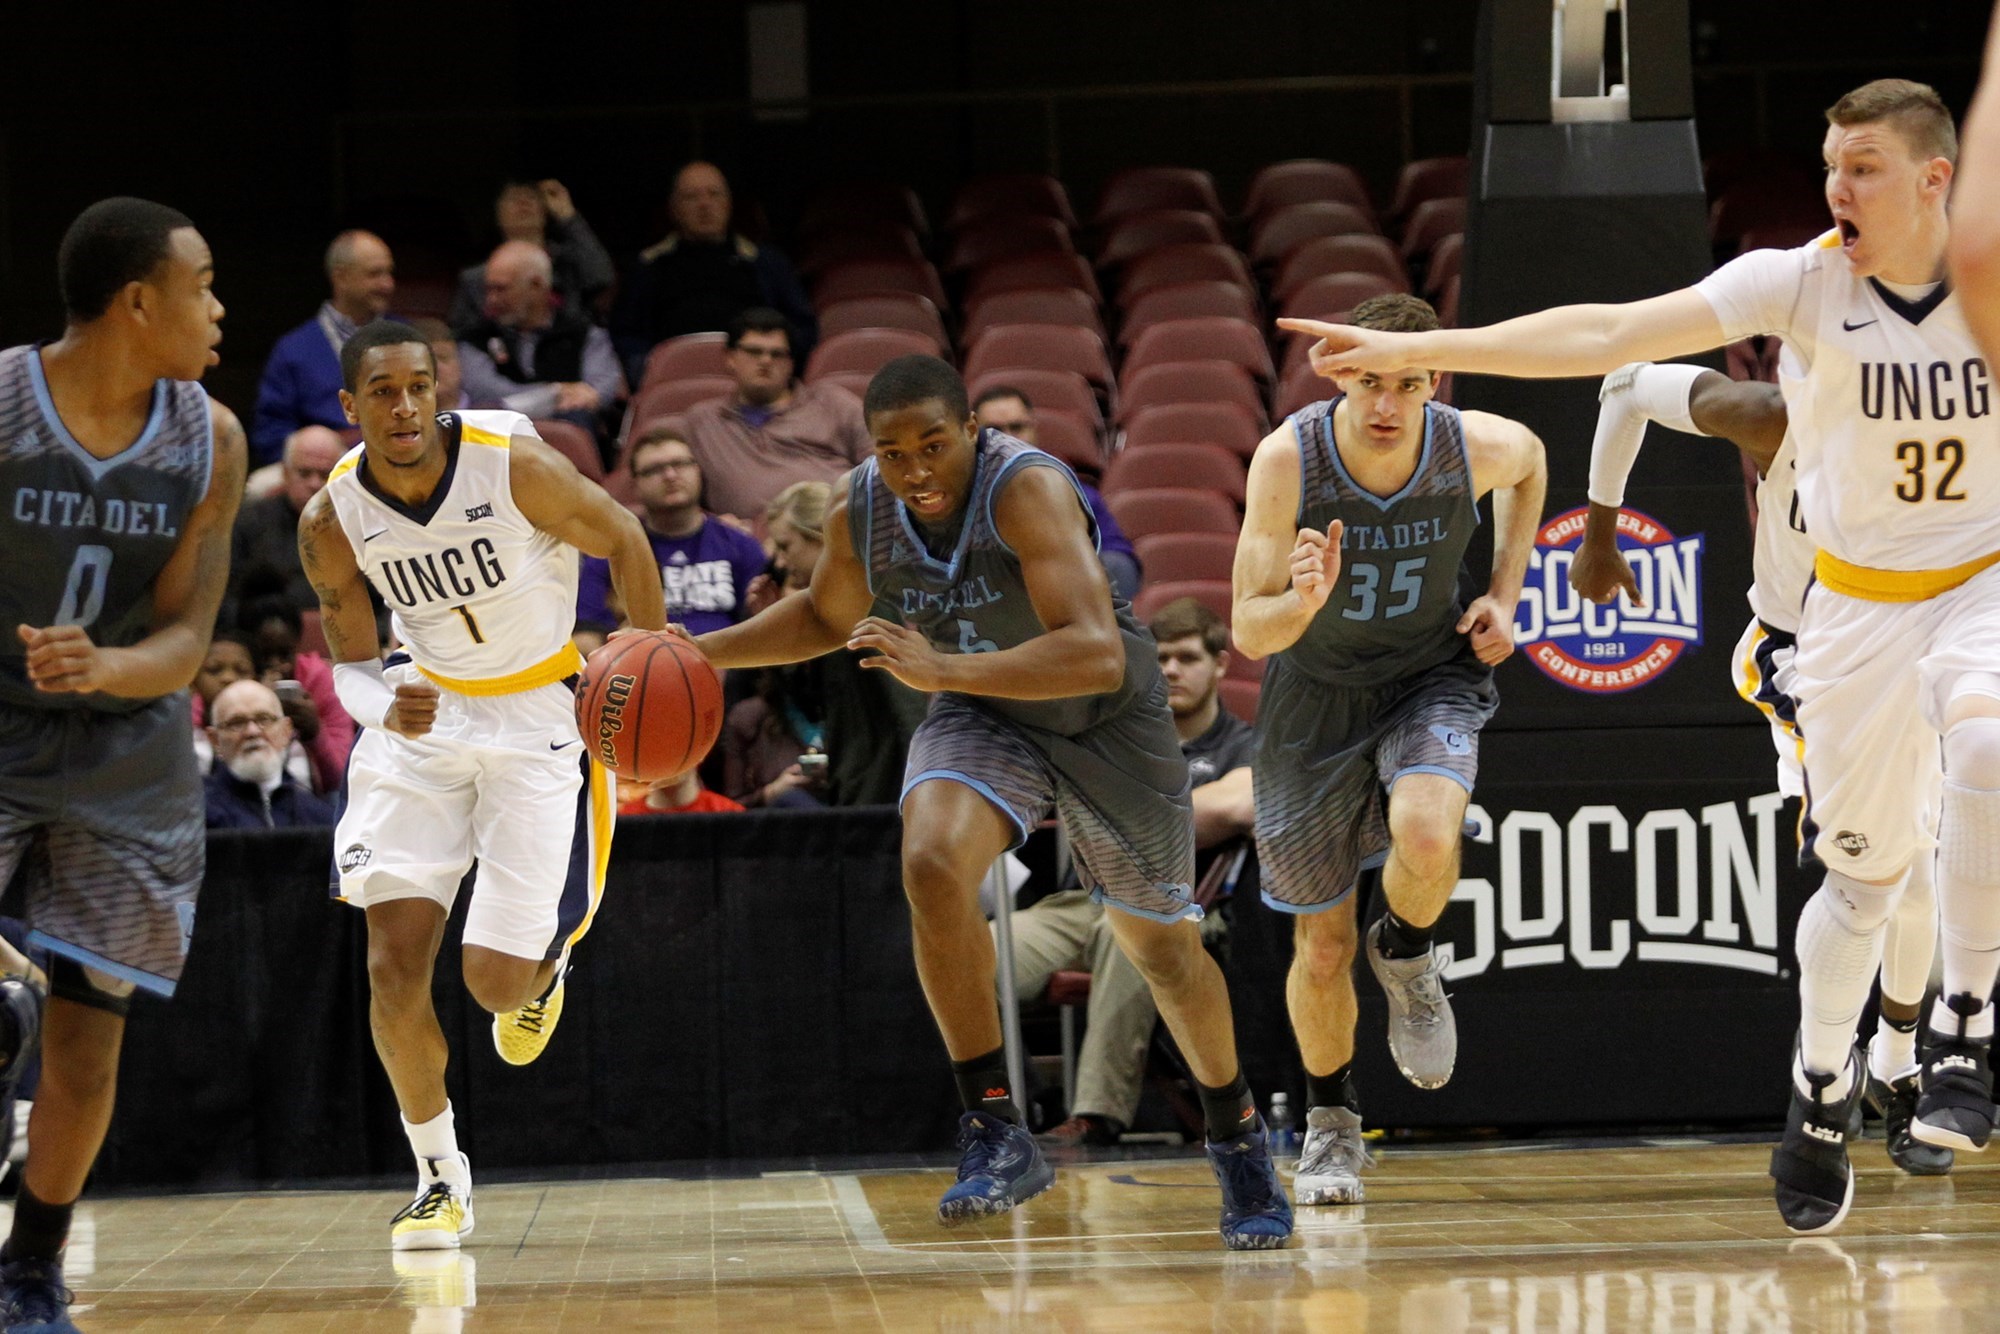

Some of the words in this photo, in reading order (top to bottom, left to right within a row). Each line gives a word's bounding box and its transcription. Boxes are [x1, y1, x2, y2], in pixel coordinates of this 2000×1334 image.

[1861, 358, 1990, 421] UNCG
[1895, 435, 1968, 504] 32
[14, 487, 177, 537] CITADEL
[1341, 516, 1448, 550] ITADEL
[1545, 513, 1659, 545] SOUERN
[55, 545, 113, 627] 0
[381, 538, 506, 607] UNCG
[1341, 556, 1428, 621] 35
[450, 604, 486, 644] 1
[1583, 643, 1626, 658] 1921
[1537, 643, 1673, 686] CONFERENCE
[599, 674, 637, 767] Wilson
